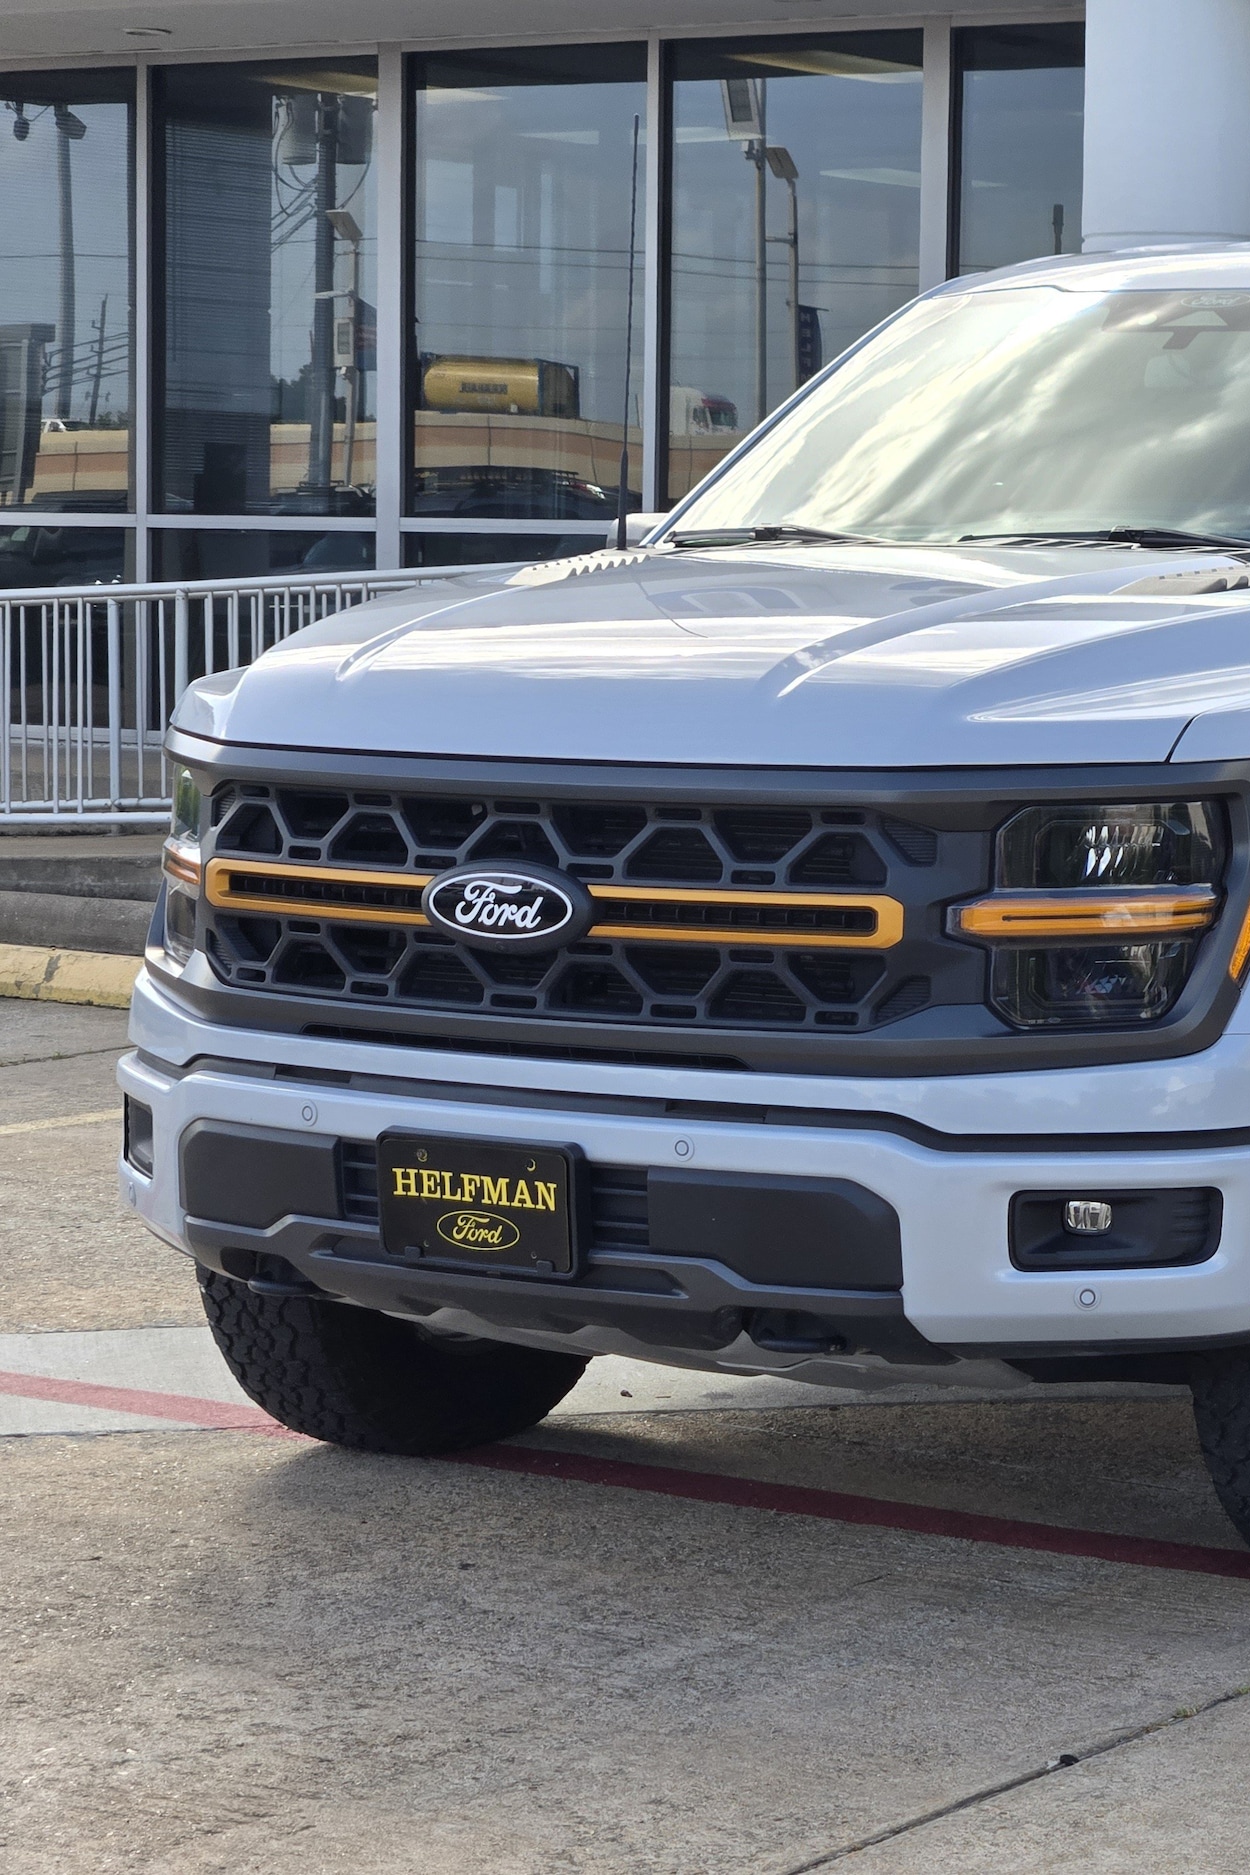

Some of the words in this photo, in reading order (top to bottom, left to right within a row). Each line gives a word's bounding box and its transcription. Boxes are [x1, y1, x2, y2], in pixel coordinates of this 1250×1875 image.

[455, 880, 544, 929] Ford
[392, 1167, 558, 1212] HELFMAN
[452, 1214, 503, 1244] Ford
